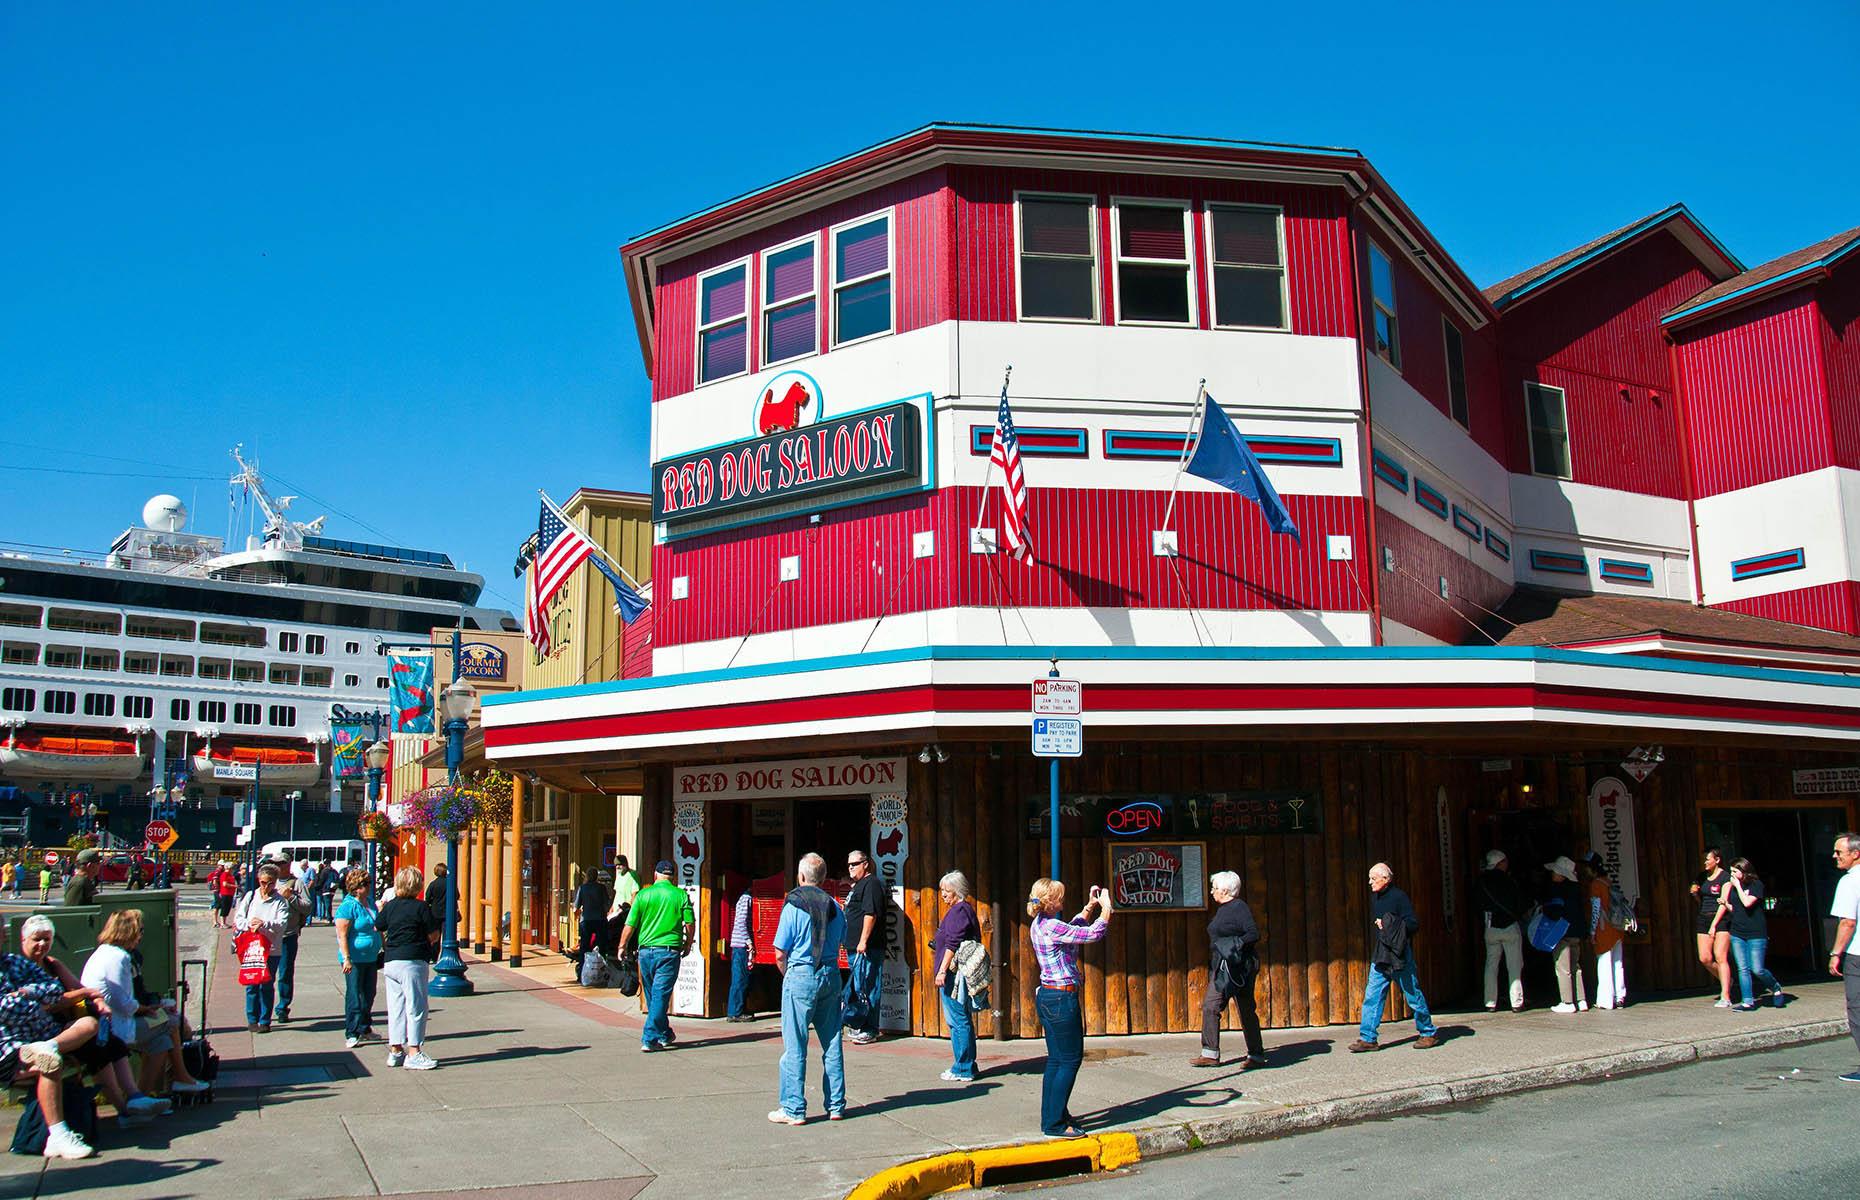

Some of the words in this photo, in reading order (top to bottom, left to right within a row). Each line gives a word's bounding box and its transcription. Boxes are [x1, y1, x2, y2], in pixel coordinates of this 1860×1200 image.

[662, 457, 714, 514] RED
[720, 443, 773, 502] DOG
[778, 413, 895, 490] SALOON
[460, 666, 501, 676] OPCORN
[1035, 683, 1047, 694] NO
[1049, 684, 1077, 693] PARKING
[215, 768, 233, 776] MANILA
[234, 768, 254, 777] SQUARE
[680, 771, 728, 794] RED
[735, 768, 785, 792] DOG
[790, 761, 898, 790] SALOON
[877, 799, 902, 811] WORLD
[876, 810, 903, 821] FAMOUS
[1107, 809, 1161, 829] OPEN
[147, 827, 170, 837] STOP
[1119, 851, 1145, 872] RED
[1149, 851, 1174, 873] DOG
[1119, 886, 1174, 905] SALOON
